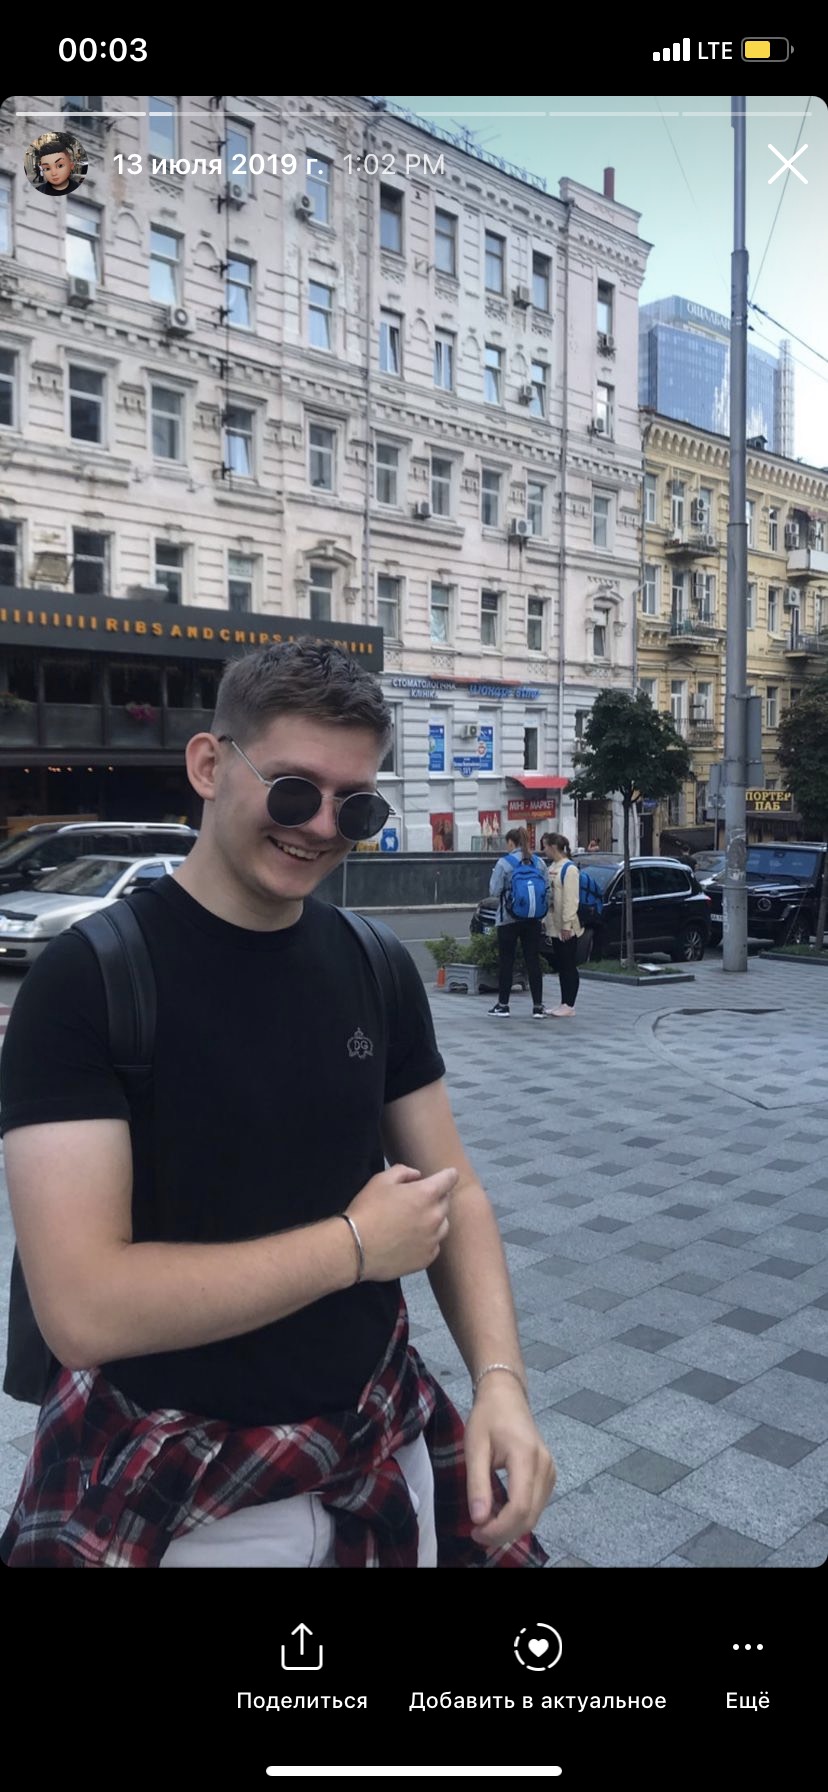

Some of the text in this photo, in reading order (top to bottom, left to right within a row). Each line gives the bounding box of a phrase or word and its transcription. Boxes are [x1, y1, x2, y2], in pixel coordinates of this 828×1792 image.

[106, 618, 163, 636] RIBS
[171, 624, 214, 640] AND
[745, 791, 792, 801] ПОРТЕР
[755, 801, 781, 811] ПАБ
